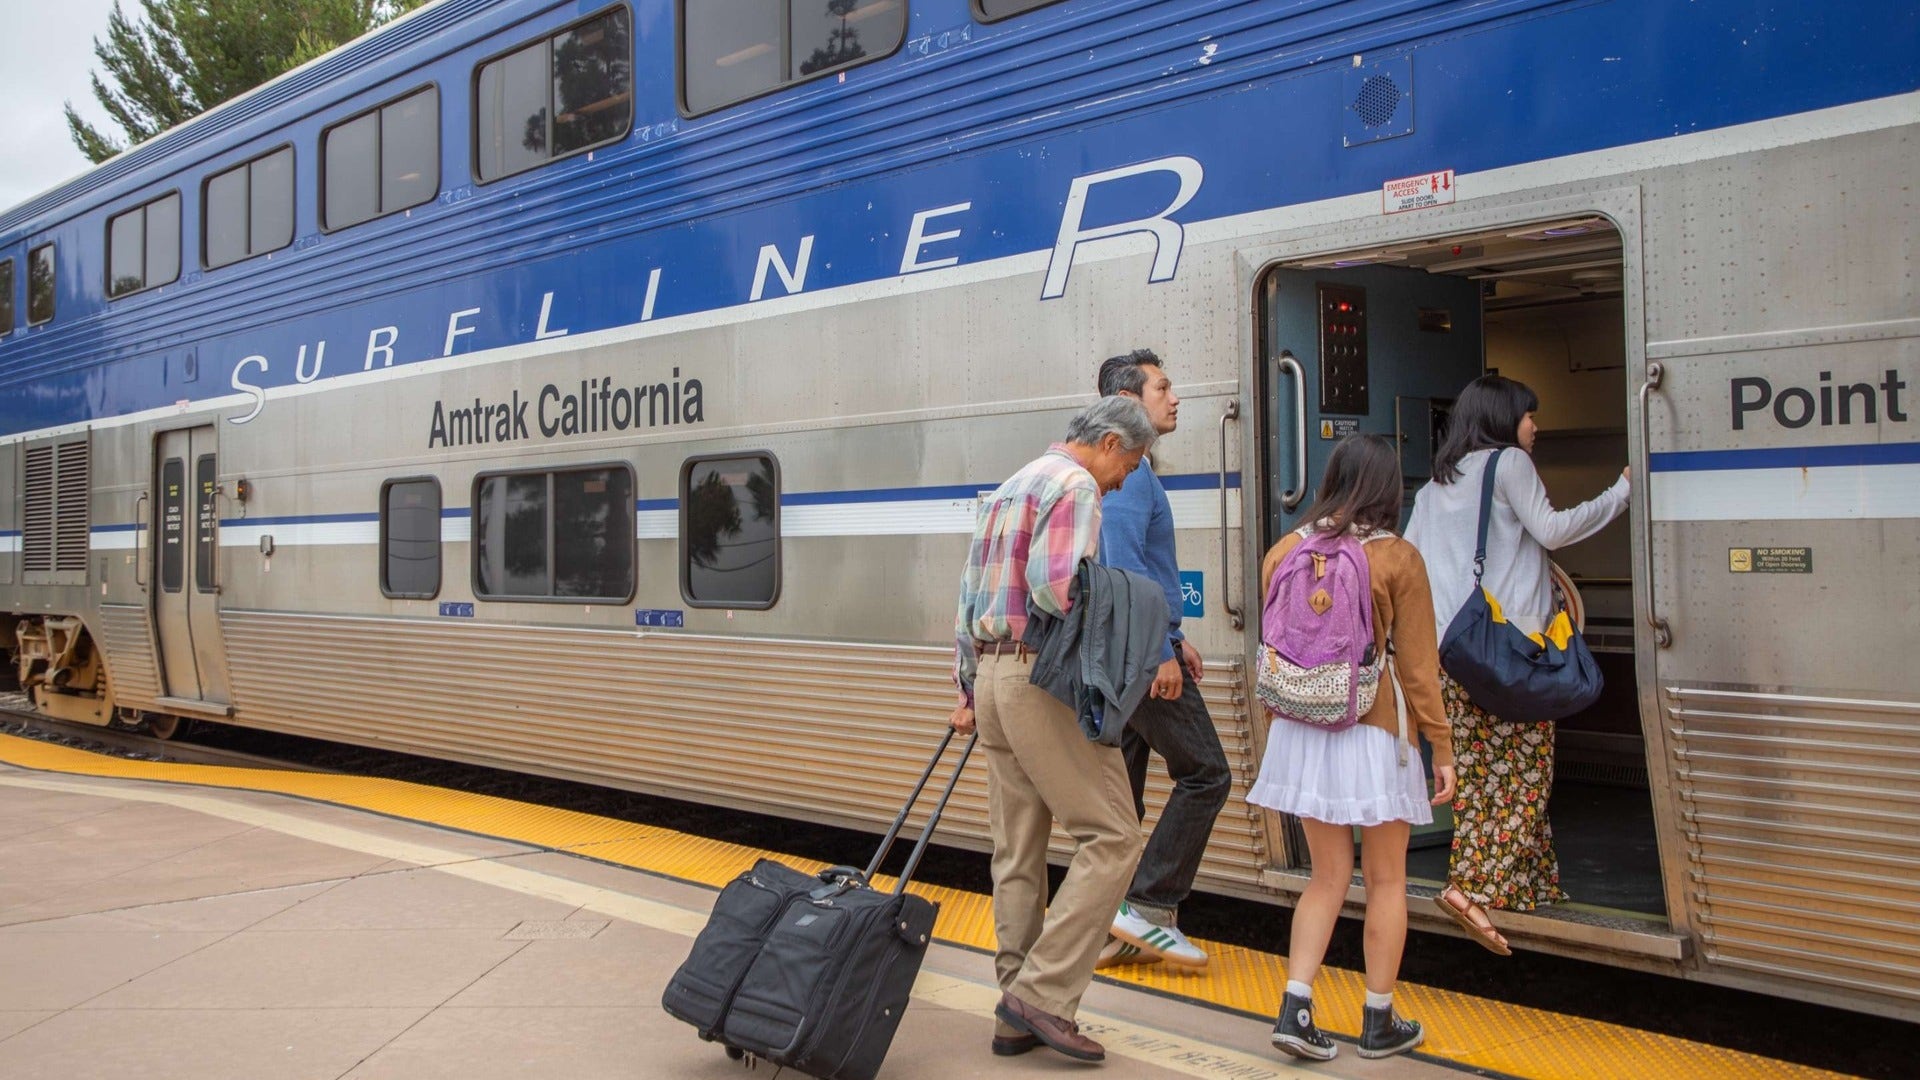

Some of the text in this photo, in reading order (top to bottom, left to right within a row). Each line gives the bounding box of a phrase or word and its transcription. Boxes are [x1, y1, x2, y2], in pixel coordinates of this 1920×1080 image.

[1387, 177, 1429, 191] EMERGENCY
[1393, 187, 1419, 198] ACCESS
[1401, 194, 1434, 205] SLIDE DOORS
[1424, 199, 1438, 207] OPEN
[1731, 369, 1907, 430] Point
[428, 367, 704, 449] Amtrak California
